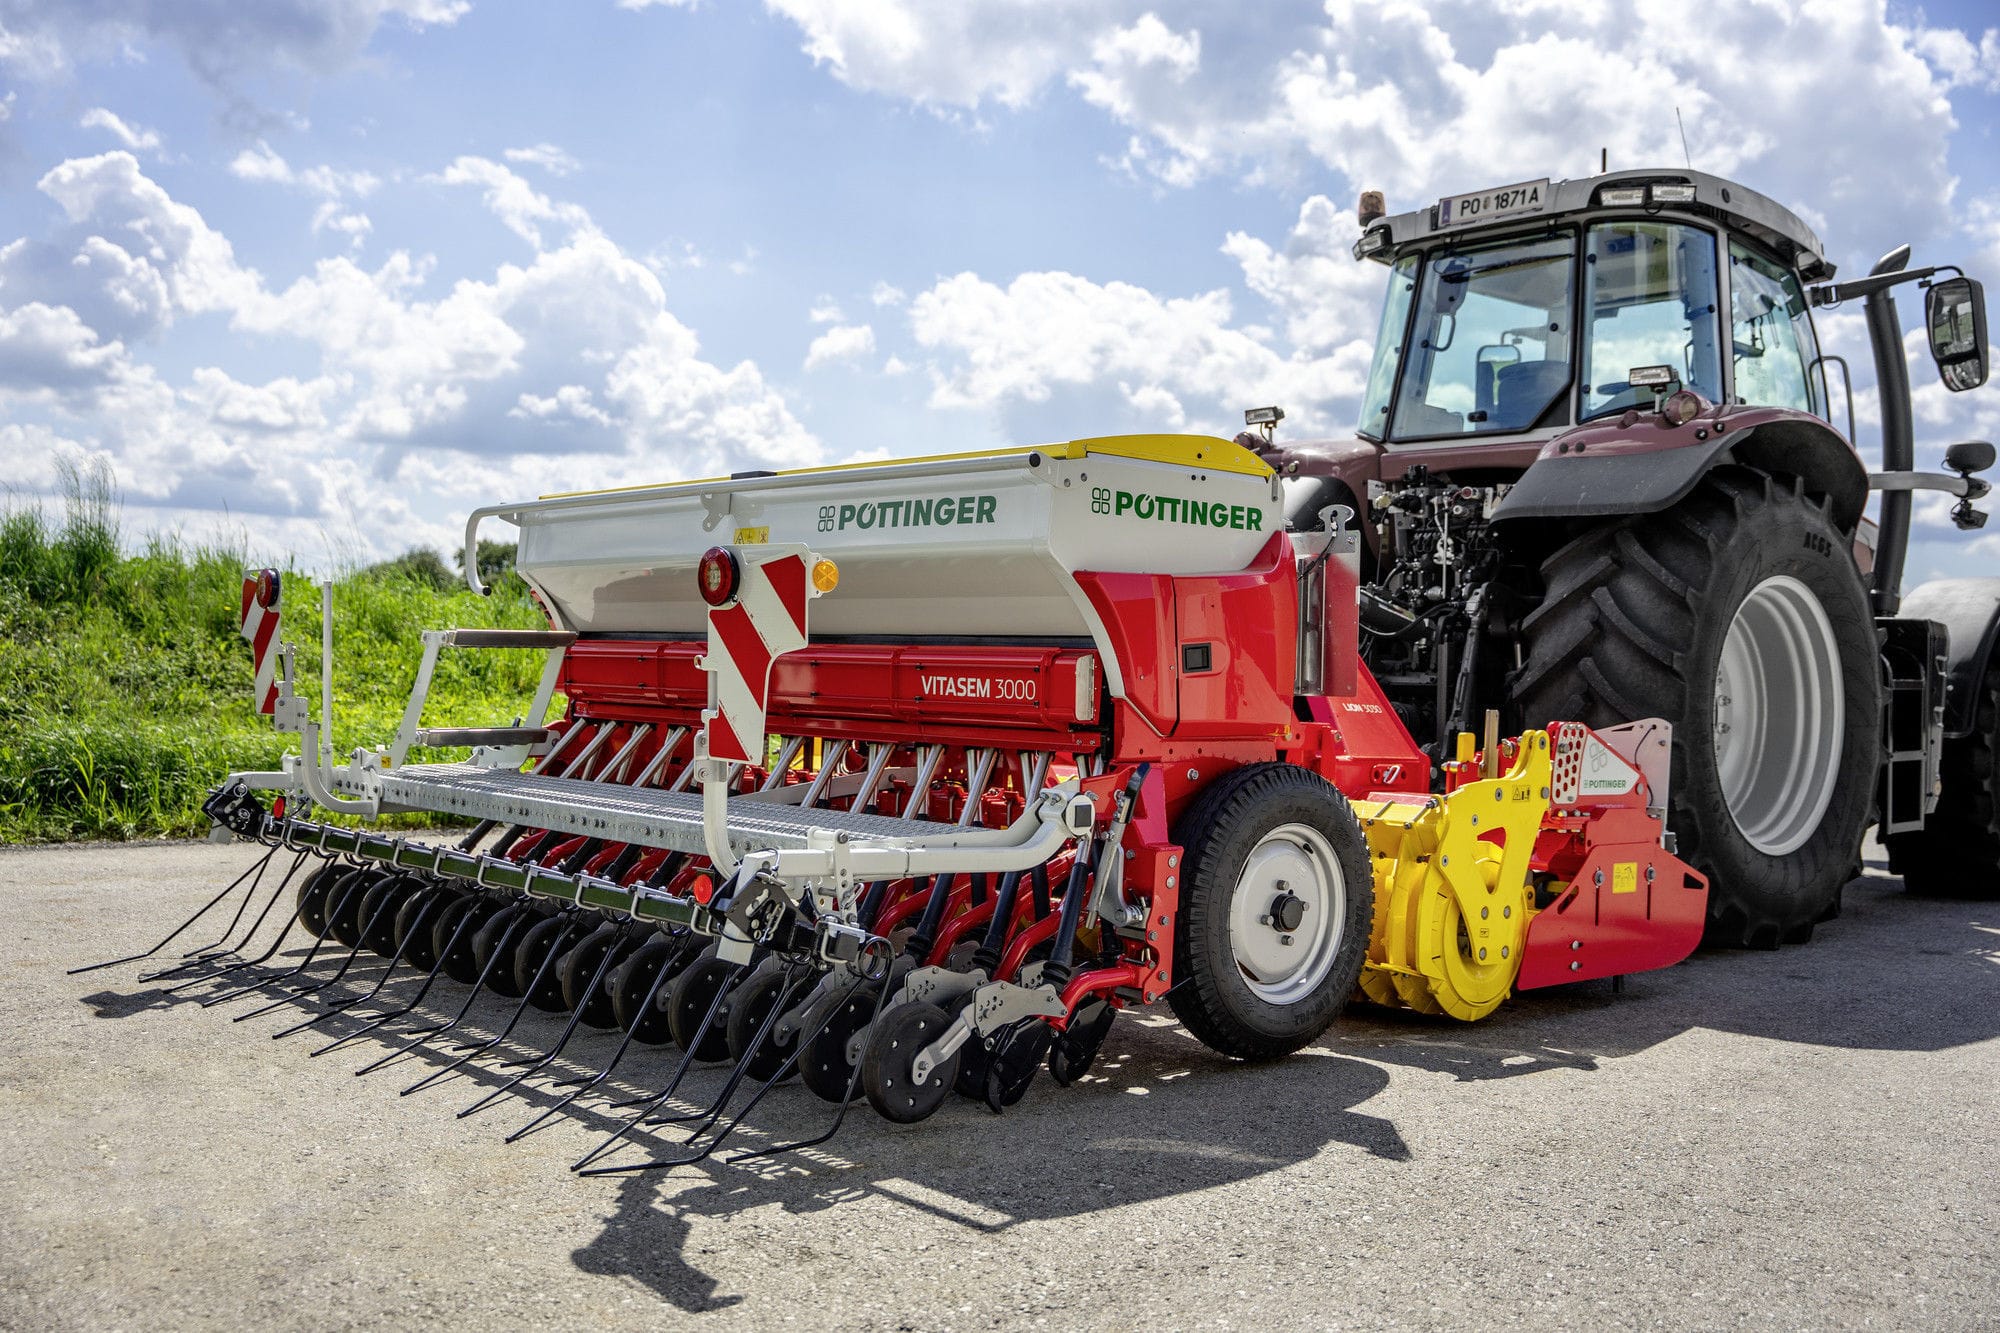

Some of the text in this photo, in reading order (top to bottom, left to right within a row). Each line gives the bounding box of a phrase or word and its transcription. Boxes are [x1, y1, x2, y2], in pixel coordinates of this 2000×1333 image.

[1460, 199, 1480, 216] PO
[838, 495, 997, 530] PÖTTINGER
[1115, 490, 1263, 532] PÖTTINGER
[921, 675, 1036, 700] VITASEM 3000
